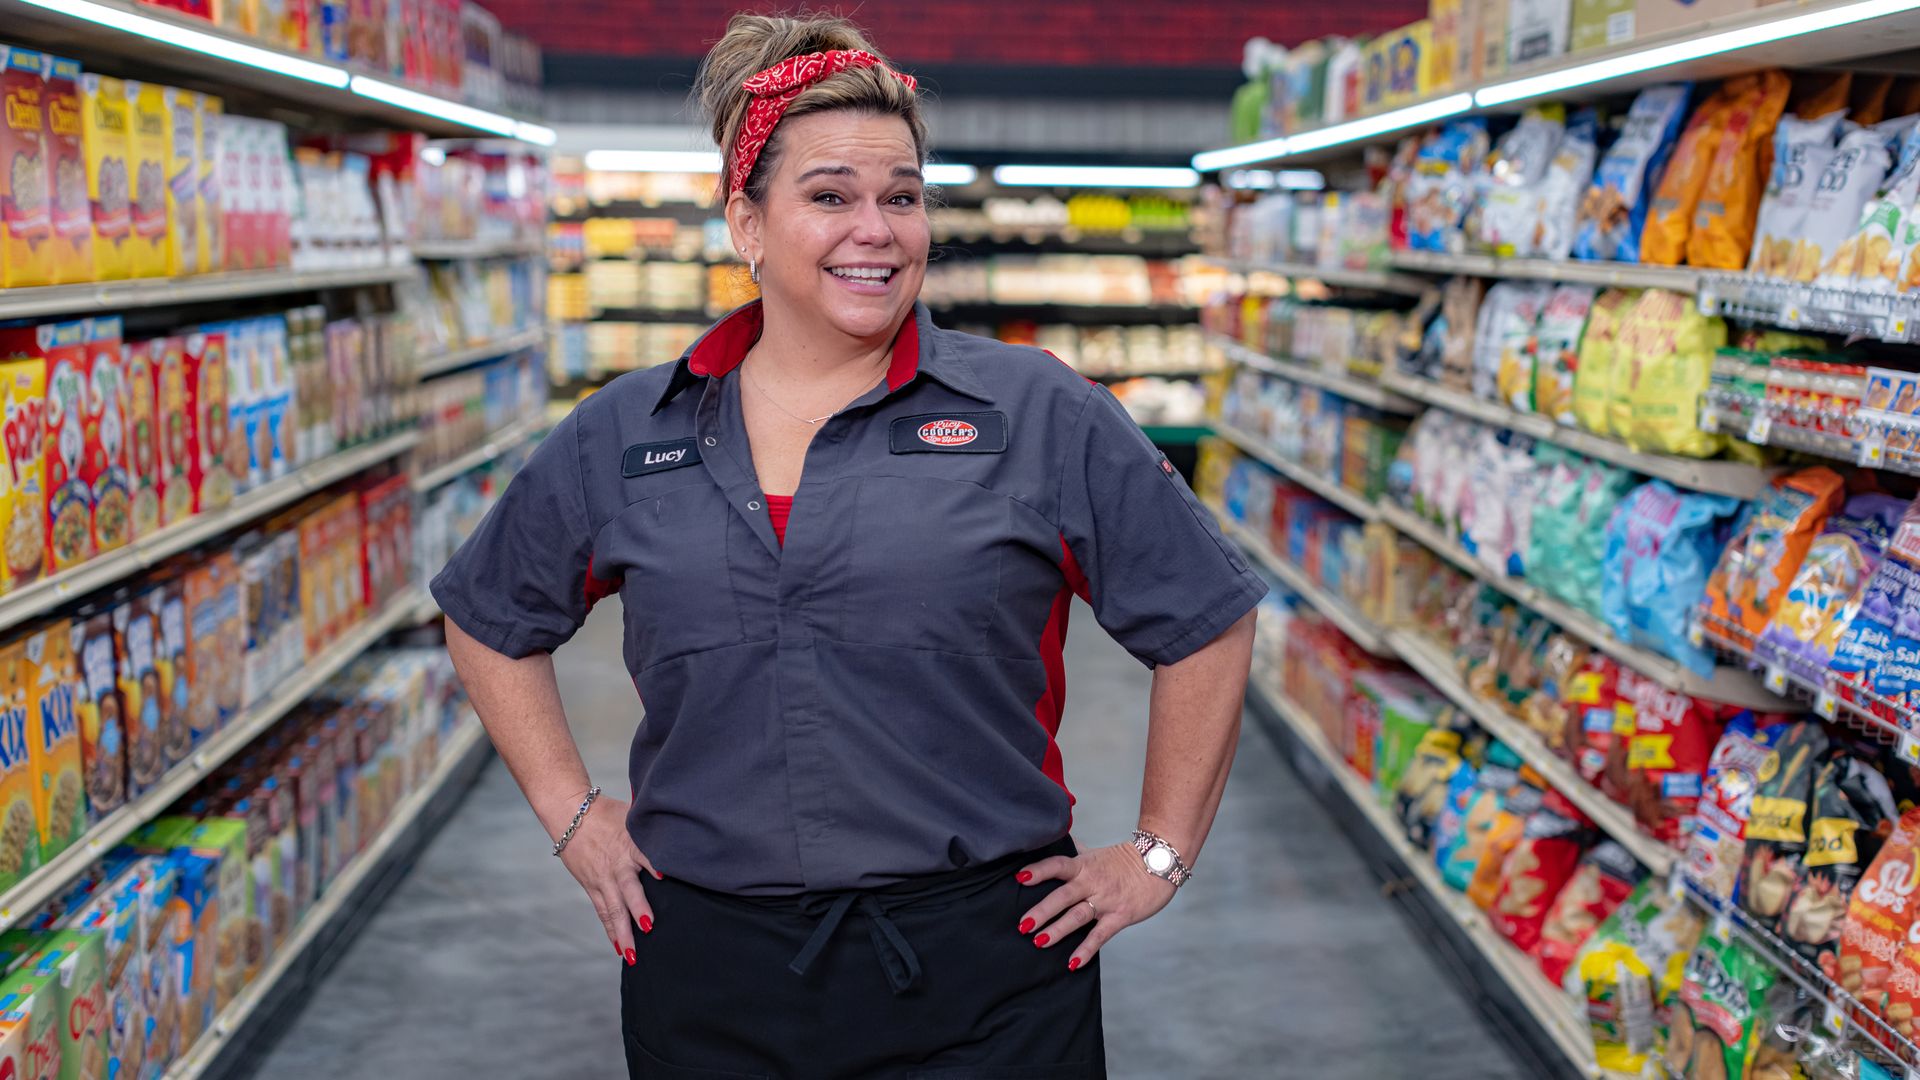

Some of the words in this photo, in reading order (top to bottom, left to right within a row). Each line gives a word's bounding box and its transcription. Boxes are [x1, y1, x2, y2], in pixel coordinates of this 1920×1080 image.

[922, 428, 974, 437] COOPER'S
[644, 448, 687, 465] Lucy
[1895, 646, 1920, 665] Sal
[40, 683, 77, 751] KIX
